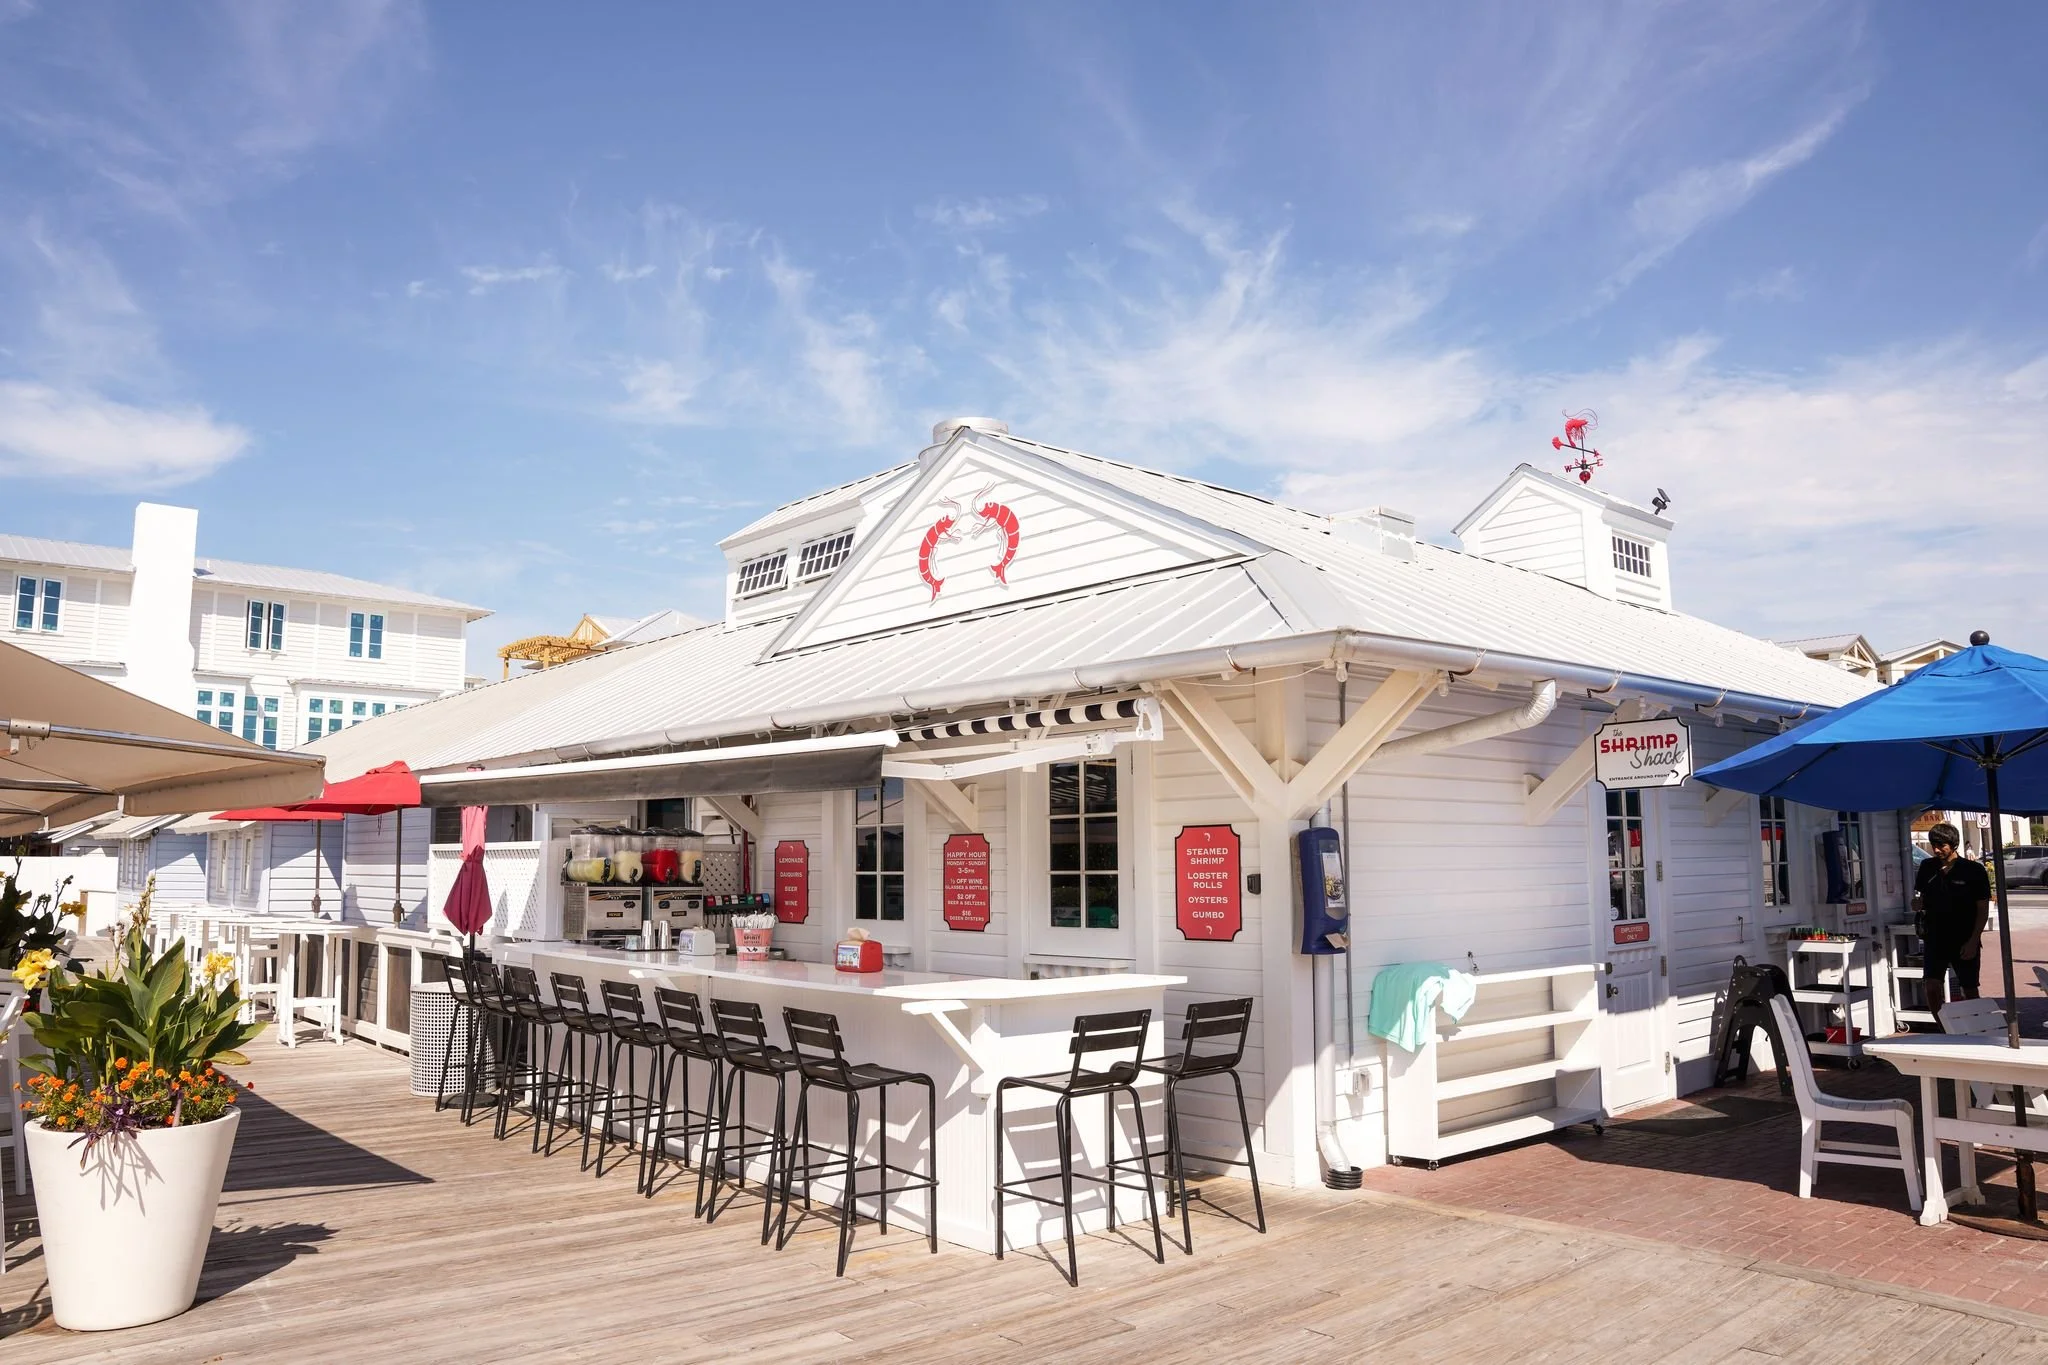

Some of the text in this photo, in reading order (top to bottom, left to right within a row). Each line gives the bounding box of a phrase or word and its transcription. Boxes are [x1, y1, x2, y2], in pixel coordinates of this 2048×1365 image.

[1613, 728, 1623, 736] the
[1600, 733, 1678, 753] SHRIMP
[1630, 743, 1685, 769] Shack
[1186, 848, 1229, 856] STEAMED
[1190, 857, 1225, 865] SHRIMP
[1187, 872, 1228, 880] LOBSTER
[1193, 881, 1223, 889] ROLLS
[1188, 896, 1228, 904] OYSTERS
[1192, 911, 1225, 919] GUMBO
